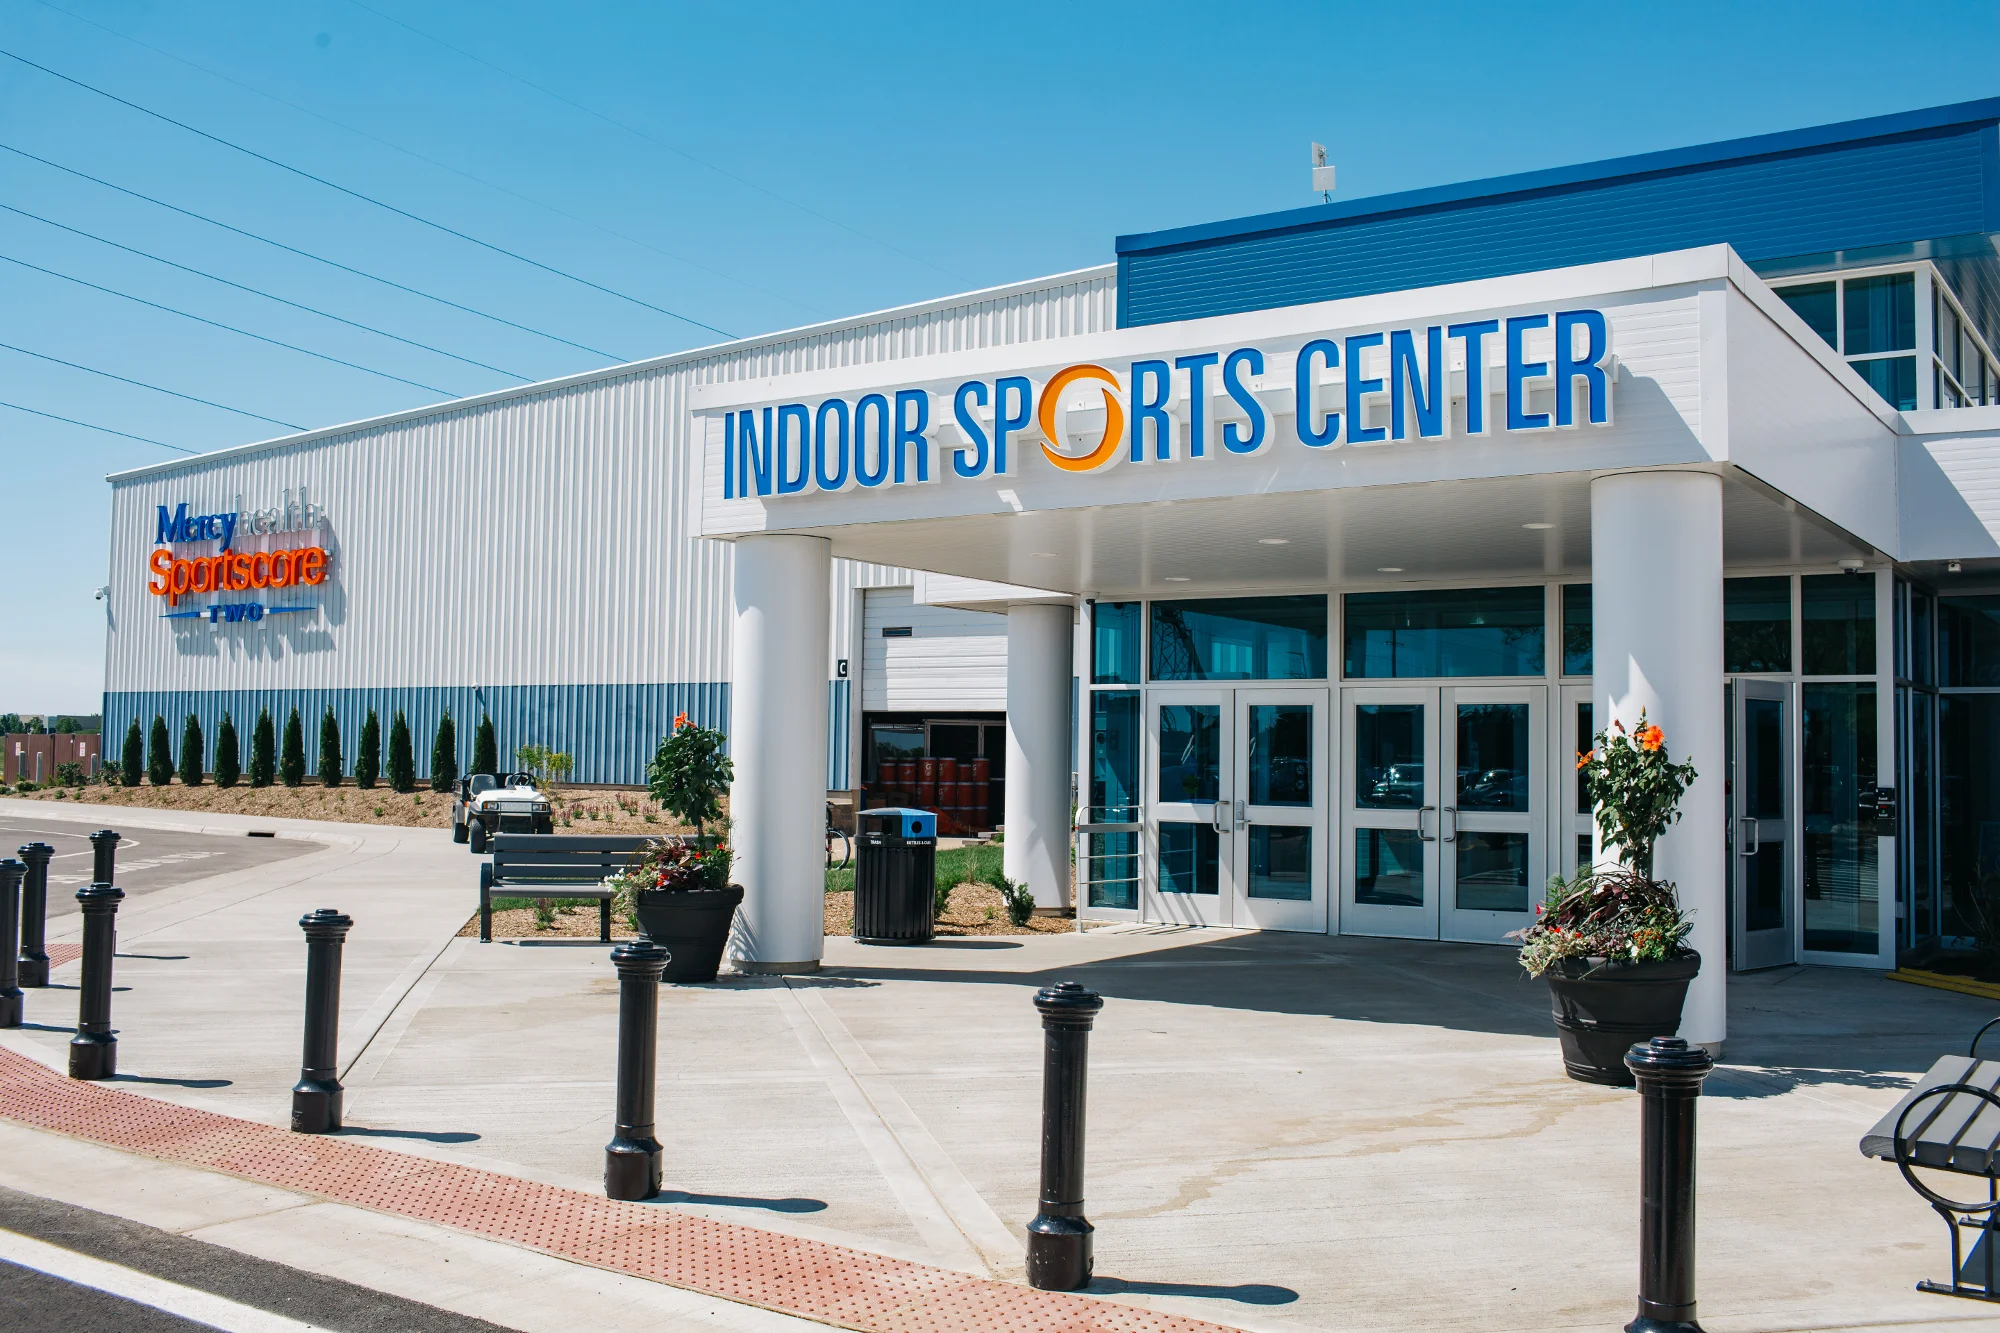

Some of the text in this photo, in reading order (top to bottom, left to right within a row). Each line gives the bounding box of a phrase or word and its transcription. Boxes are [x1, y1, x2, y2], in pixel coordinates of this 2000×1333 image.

[724, 308, 1609, 500] INDOOR SPORTS CENTER
[149, 547, 326, 606] Sportscore
[206, 602, 264, 624] TWO
[840, 662, 846, 675] C
